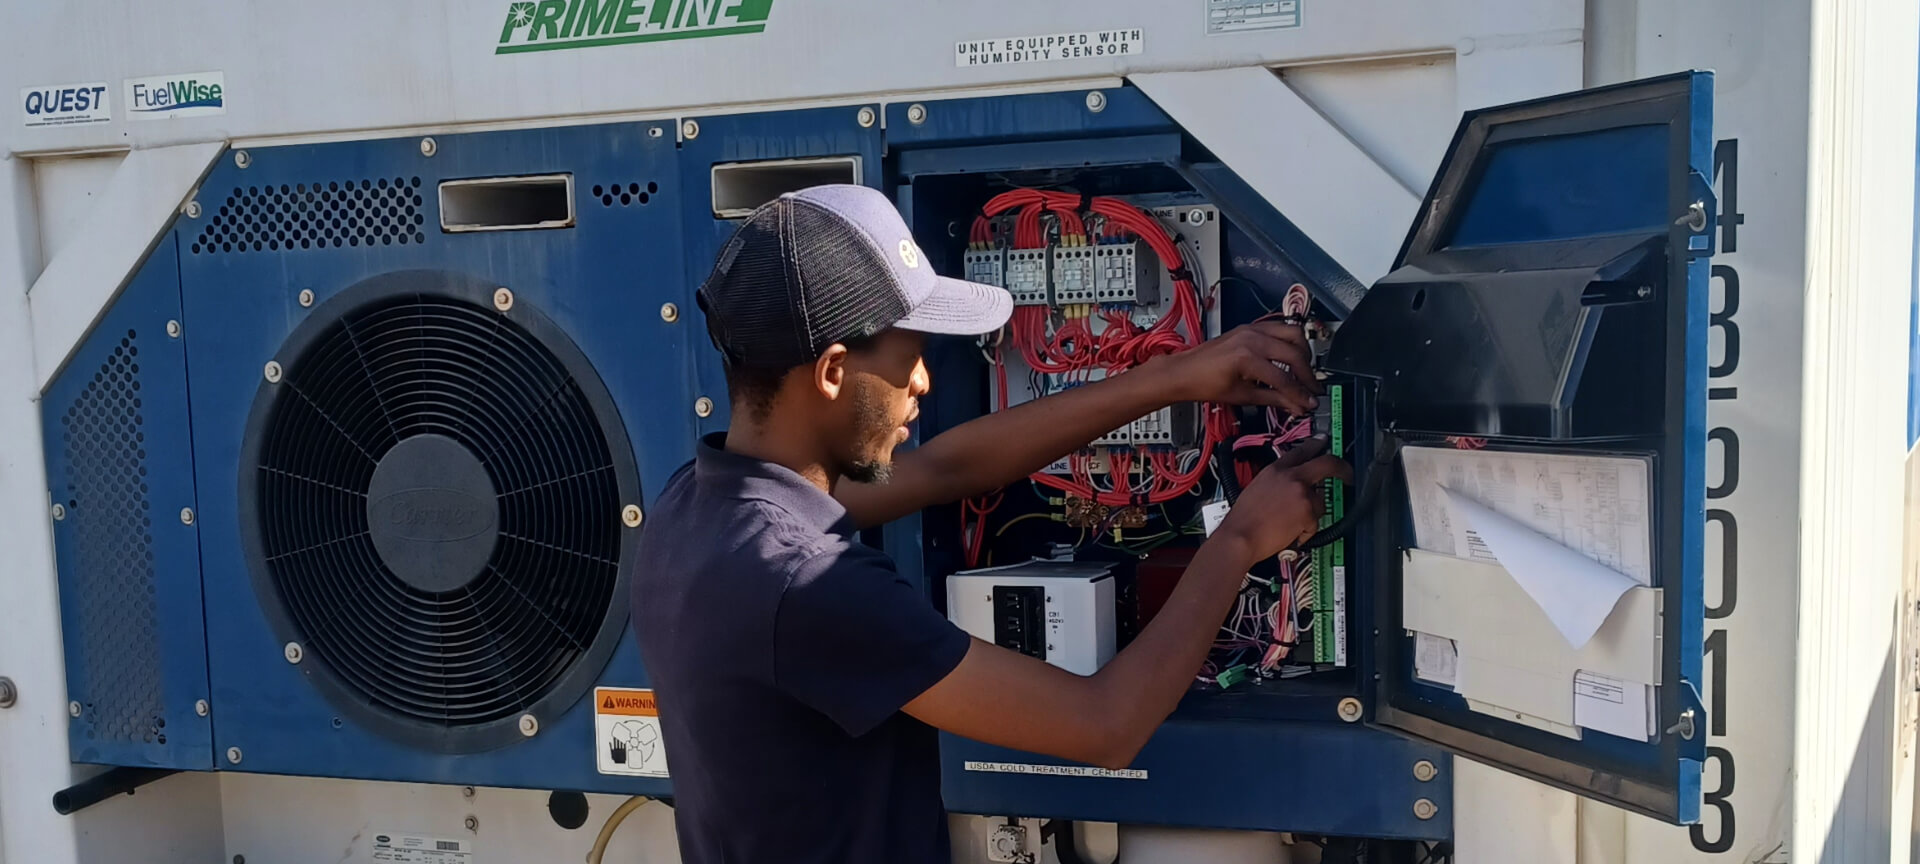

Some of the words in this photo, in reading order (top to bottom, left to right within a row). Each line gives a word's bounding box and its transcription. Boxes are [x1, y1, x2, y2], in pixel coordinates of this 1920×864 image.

[958, 41, 996, 54] UNIT
[1006, 33, 1088, 51] EQUIPPED
[1099, 30, 1141, 44] WITH
[969, 49, 1050, 65] HUMIDITY
[1062, 43, 1129, 58] SENSOR
[25, 86, 106, 115] QUEST
[133, 80, 222, 107] FuelWise
[1050, 462, 1068, 470] LINE
[616, 697, 657, 710] WARNIN
[970, 762, 995, 770] USDA
[1031, 765, 1087, 775] TREATMENT
[1091, 768, 1143, 778] CERTIFIED
